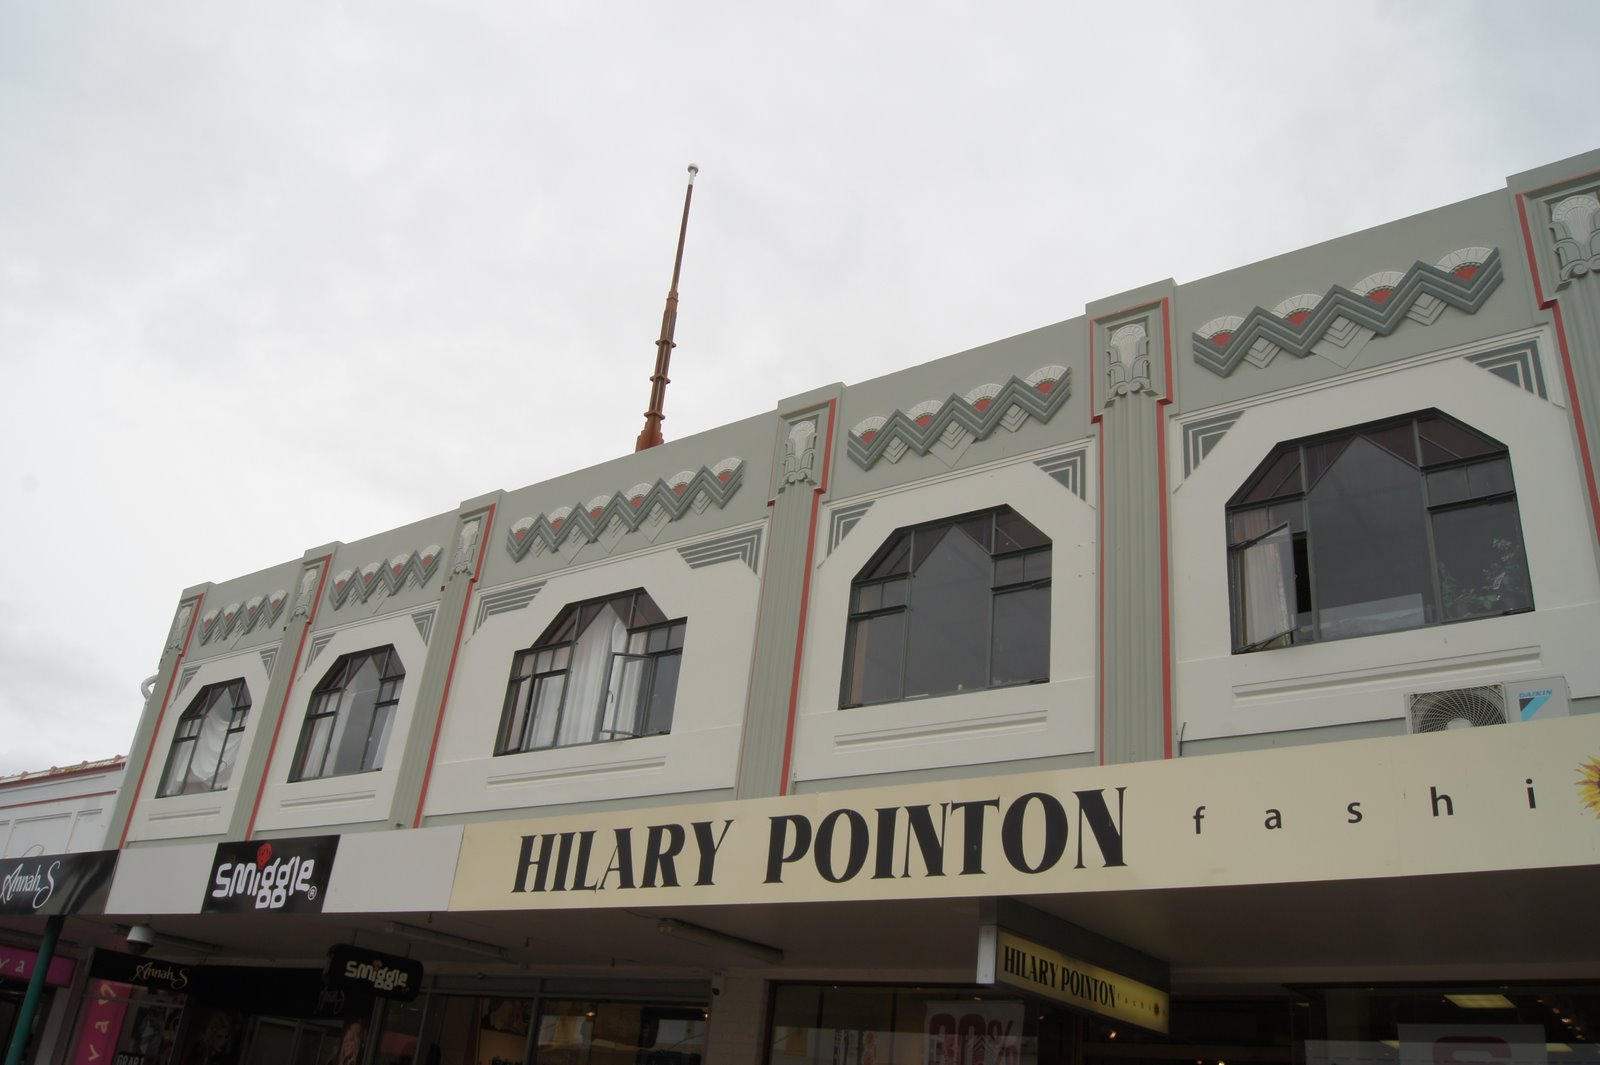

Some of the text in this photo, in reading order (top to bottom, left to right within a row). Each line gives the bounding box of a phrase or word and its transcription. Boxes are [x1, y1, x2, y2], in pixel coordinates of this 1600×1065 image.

[1519, 689, 1553, 698] DAIKIN
[511, 819, 735, 893] HILARY
[762, 786, 1128, 883] POINTON
[1004, 945, 1059, 988] HILARY
[1061, 966, 1117, 1009] POINTON
